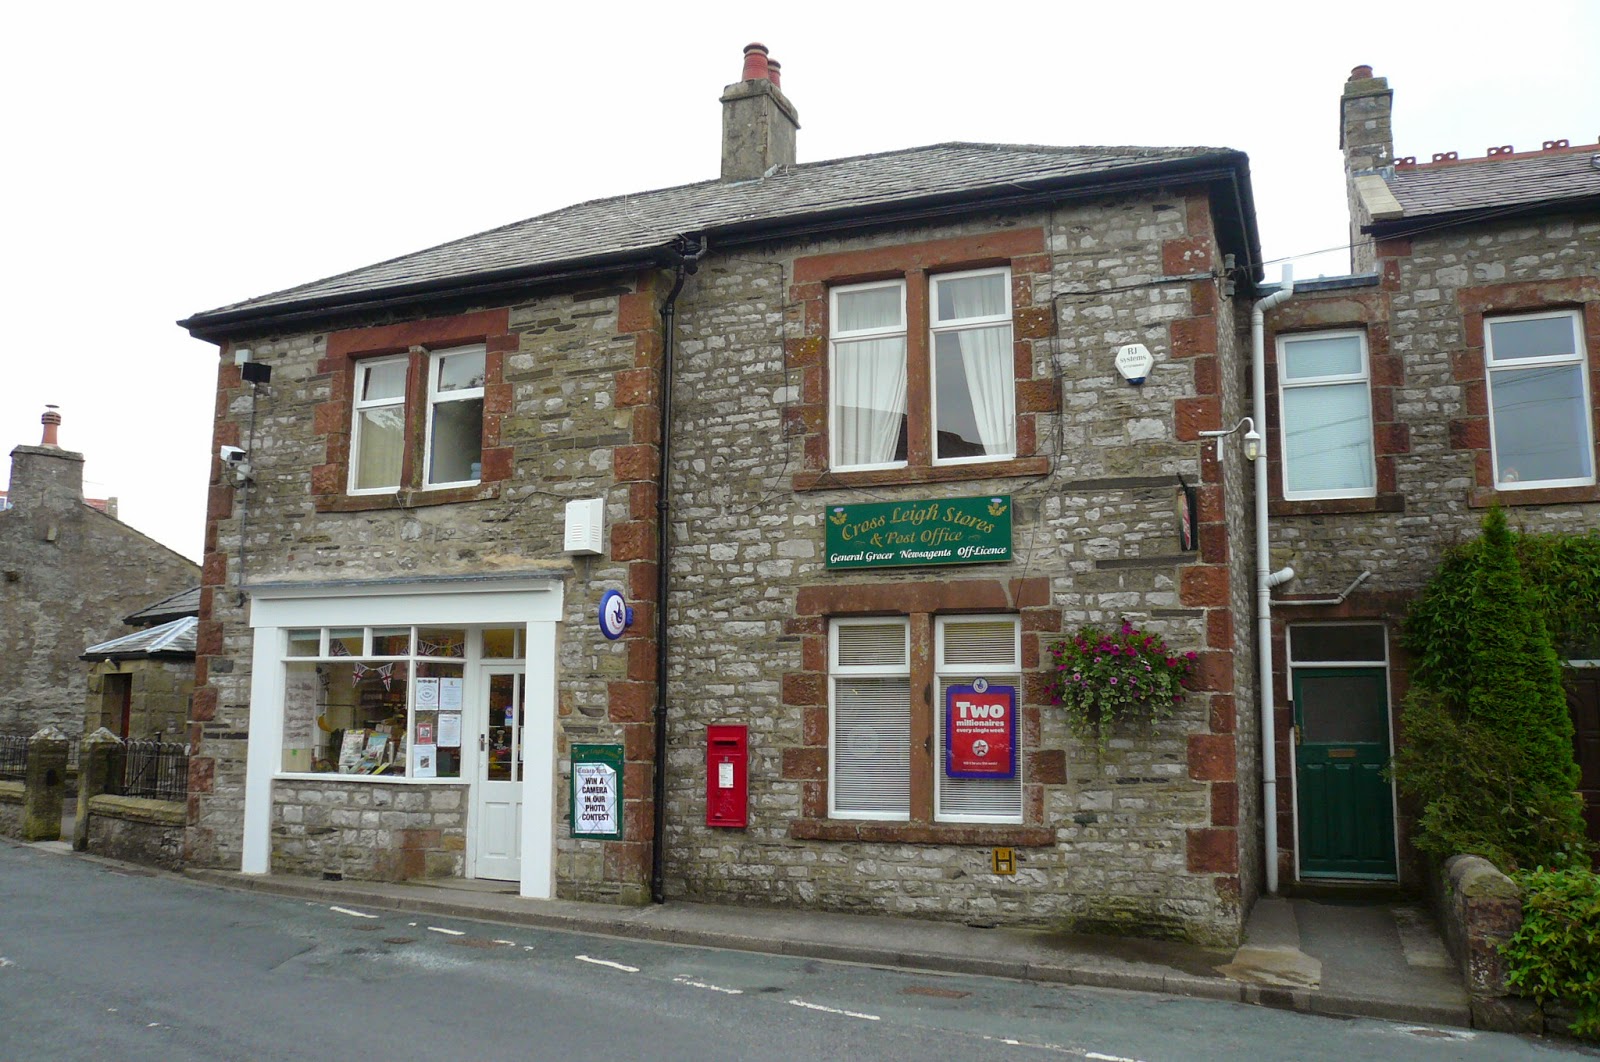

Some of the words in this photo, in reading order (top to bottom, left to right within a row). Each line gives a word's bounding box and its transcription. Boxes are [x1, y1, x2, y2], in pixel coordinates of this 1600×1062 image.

[842, 515, 886, 541] Cross
[890, 503, 939, 526] Leigh
[942, 507, 994, 533] Stores
[870, 533, 883, 547] &
[885, 531, 916, 544] Post
[920, 527, 962, 547] Office
[830, 551, 864, 563] General
[865, 551, 895, 562] Grocer
[899, 549, 952, 560] Newsagents
[957, 545, 1007, 559] Off-Licence
[956, 701, 1005, 719] Two
[956, 719, 1005, 727] millionaires
[585, 777, 598, 785] WIN
[599, 777, 604, 785] A
[582, 786, 608, 794] CAMERA
[584, 795, 591, 803] IN
[592, 795, 606, 803] OUR
[585, 804, 606, 812] PHOTO
[582, 813, 609, 821] CONTEST
[995, 850, 1012, 871] H
